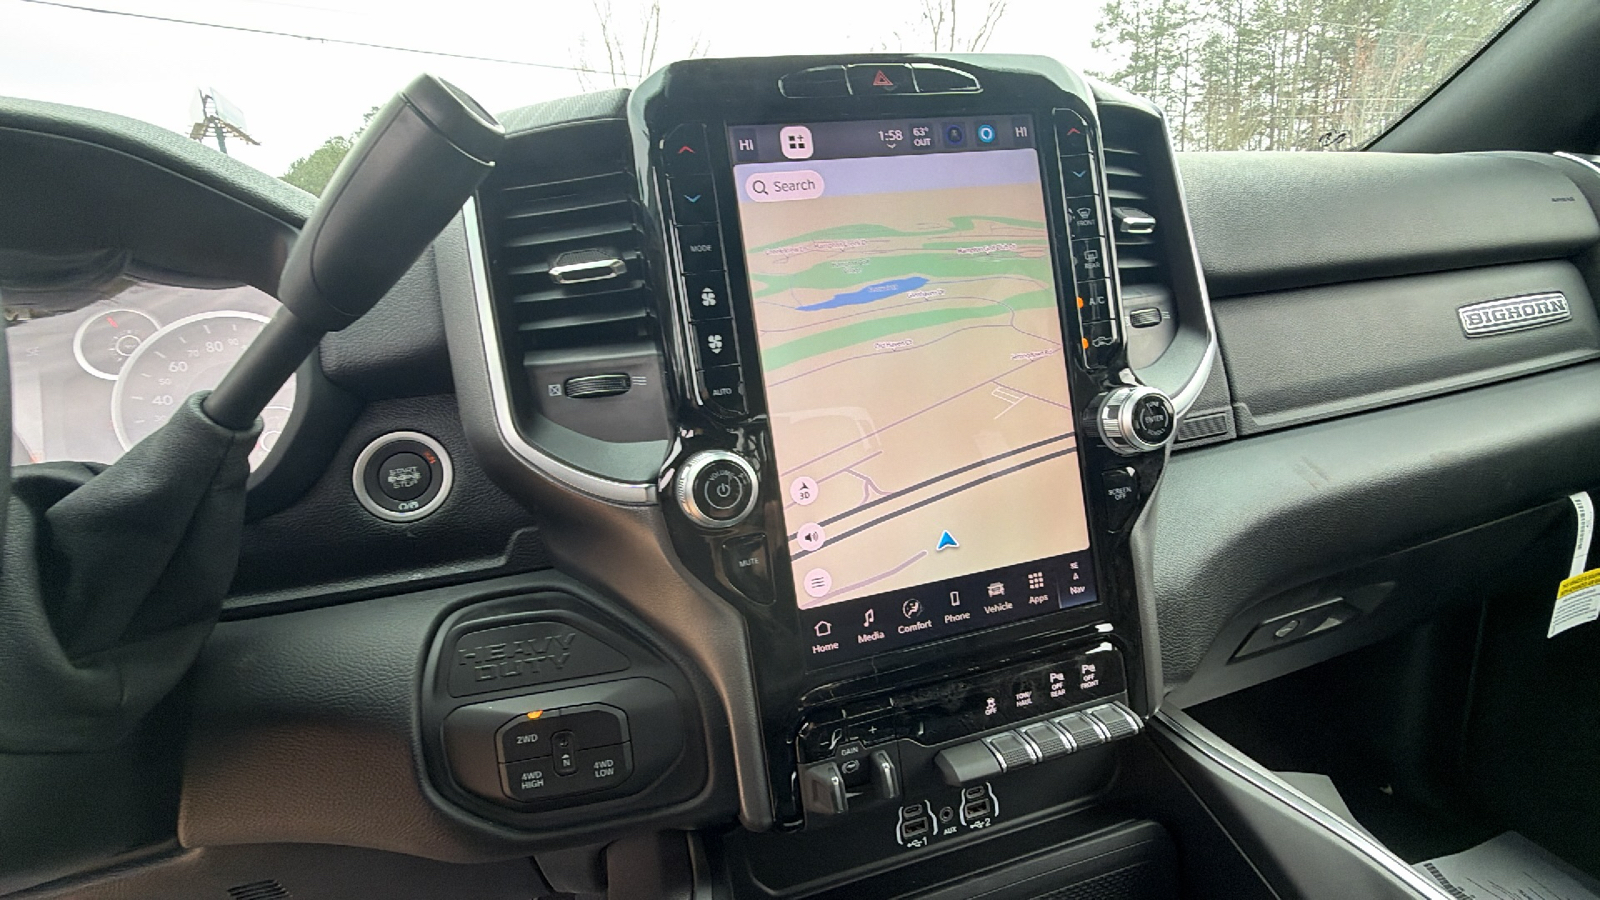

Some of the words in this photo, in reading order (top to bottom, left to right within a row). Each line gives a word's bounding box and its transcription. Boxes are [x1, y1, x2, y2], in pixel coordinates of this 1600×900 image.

[878, 129, 904, 142] 1:58
[1015, 126, 1028, 138] HI
[739, 139, 754, 151] HI
[913, 137, 931, 147] OUT
[773, 177, 816, 194] Search
[1076, 219, 1096, 227] FRONT
[690, 243, 713, 253] MODE
[1084, 261, 1101, 270] REAR
[1089, 296, 1106, 306] A/C
[204, 340, 225, 354] 80
[227, 338, 239, 346] 90
[187, 348, 200, 358] 70
[168, 360, 189, 373] 60
[158, 378, 172, 386] 50
[712, 386, 733, 397] AUTO
[152, 394, 174, 407] 40
[799, 491, 811, 500] 3D
[1107, 486, 1132, 497] SCREEN
[1114, 493, 1127, 501] OFF
[739, 557, 760, 568] MUTE
[1069, 585, 1086, 596] Nav
[1028, 593, 1049, 606] Apps
[983, 600, 1014, 616] Vehicle
[943, 610, 971, 625] Phone
[897, 620, 933, 635] Comfort
[857, 630, 885, 645] Media
[458, 632, 576, 666] HEAVY
[811, 641, 839, 655] Home
[474, 652, 571, 682] DUTY
[1082, 673, 1095, 682] OFF
[1051, 681, 1064, 690] OFF
[1080, 679, 1099, 690] FRONT
[1050, 689, 1066, 698] REAR
[1016, 698, 1033, 707] HAUL
[984, 707, 997, 716] OFF
[516, 734, 538, 744] 2WD
[841, 747, 859, 756] GAIN
[562, 758, 571, 767] N
[593, 759, 614, 770] 4WD
[521, 770, 543, 781] 4WD
[594, 767, 615, 778] LOW
[521, 778, 544, 790] HIGH
[984, 817, 992, 828] 2
[943, 825, 957, 835] AUX
[923, 836, 928, 846] 1
